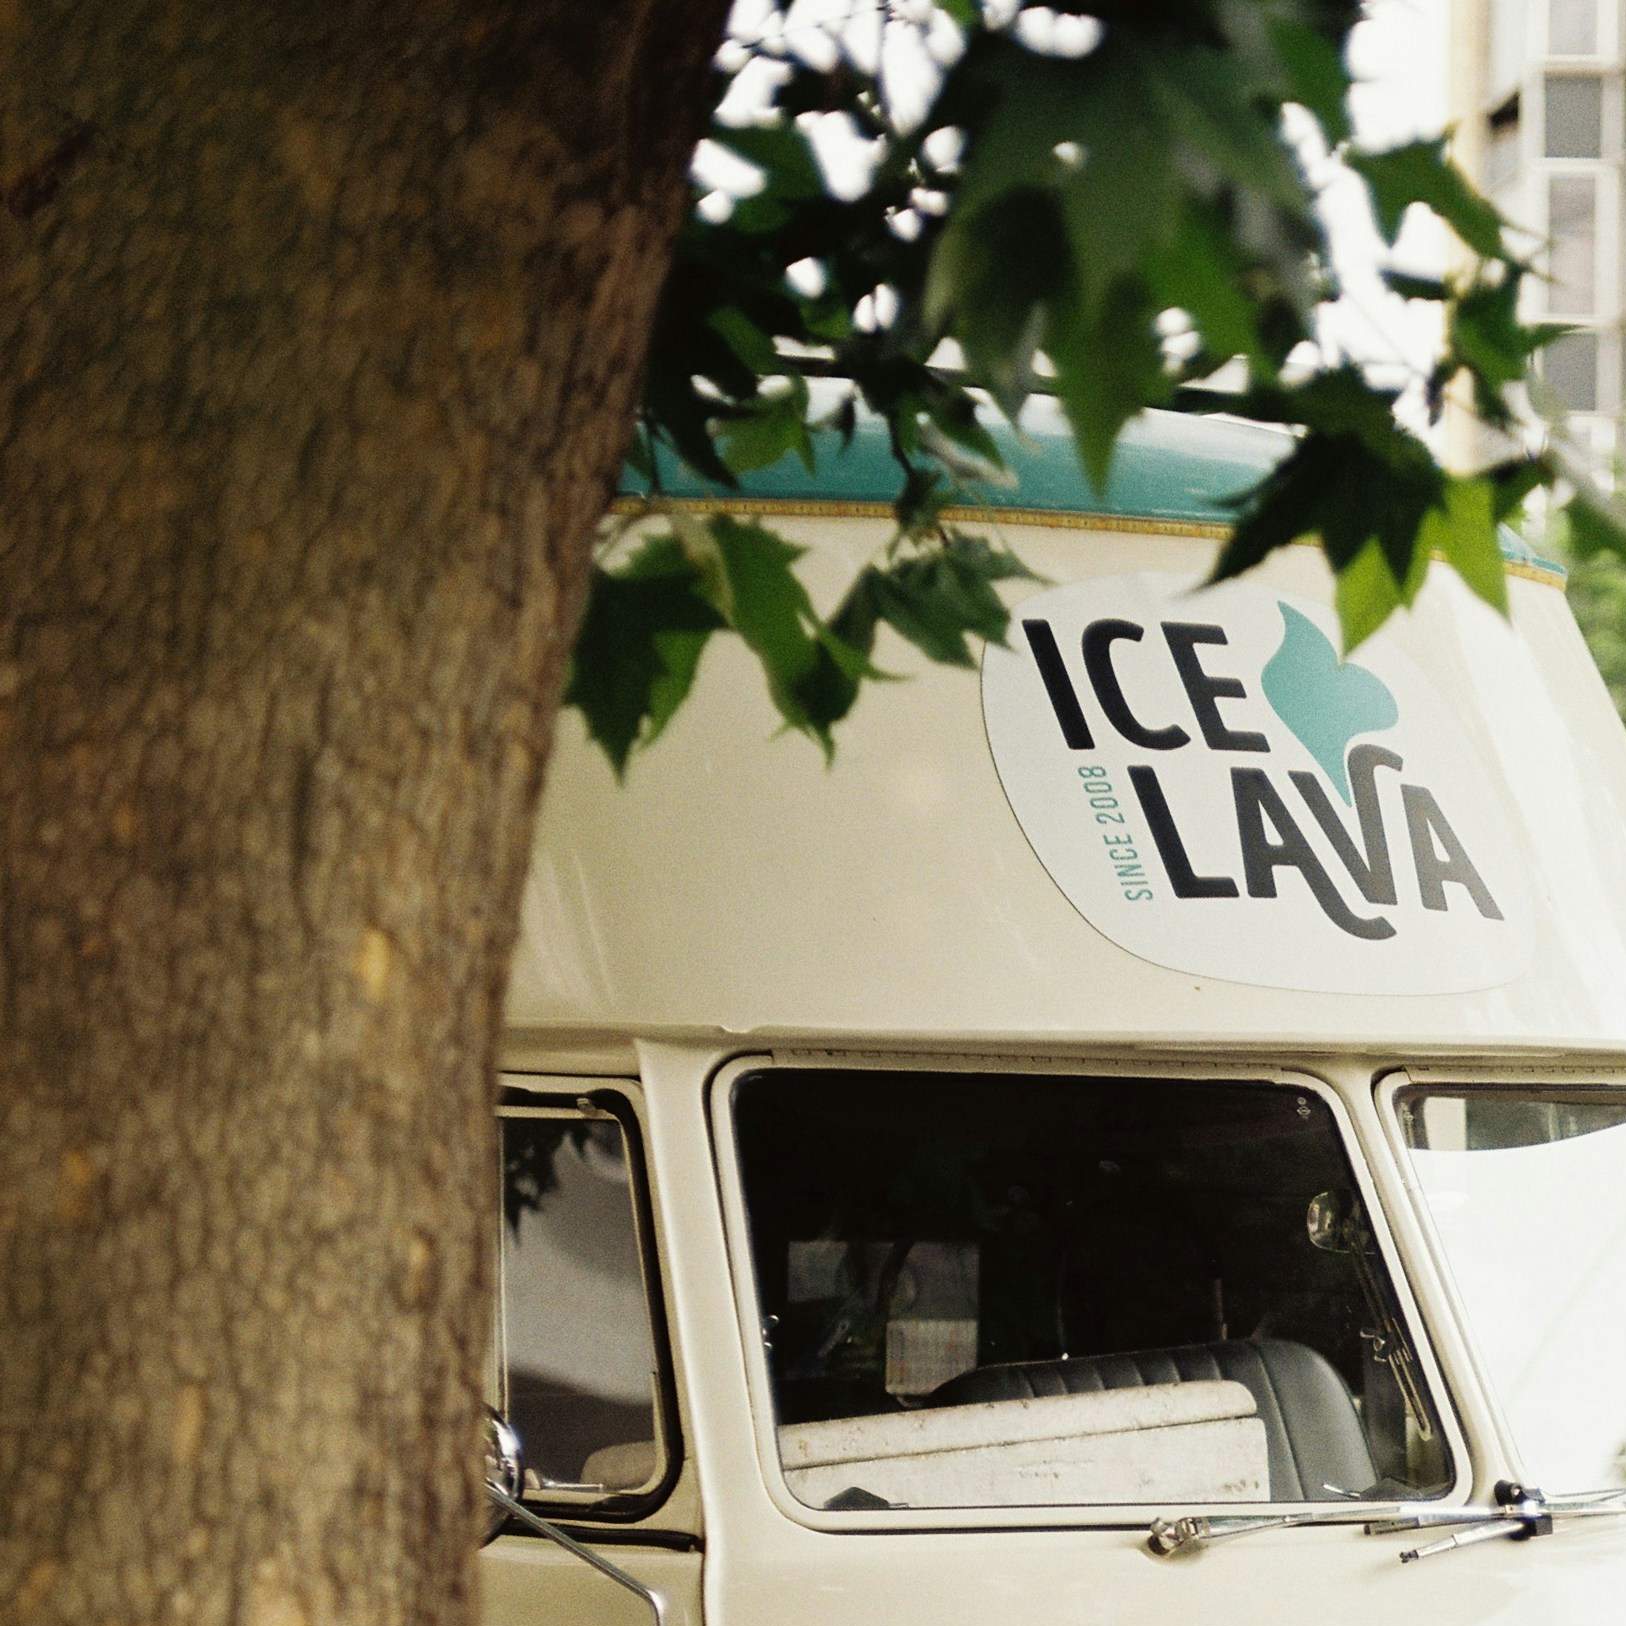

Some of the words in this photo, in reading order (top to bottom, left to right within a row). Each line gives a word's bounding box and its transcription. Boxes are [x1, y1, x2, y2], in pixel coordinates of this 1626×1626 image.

[1021, 618, 1271, 752] ICE
[1078, 766, 1125, 824] 2008
[1127, 743, 1505, 940] LAVA
[1103, 834, 1153, 901] SINCE
